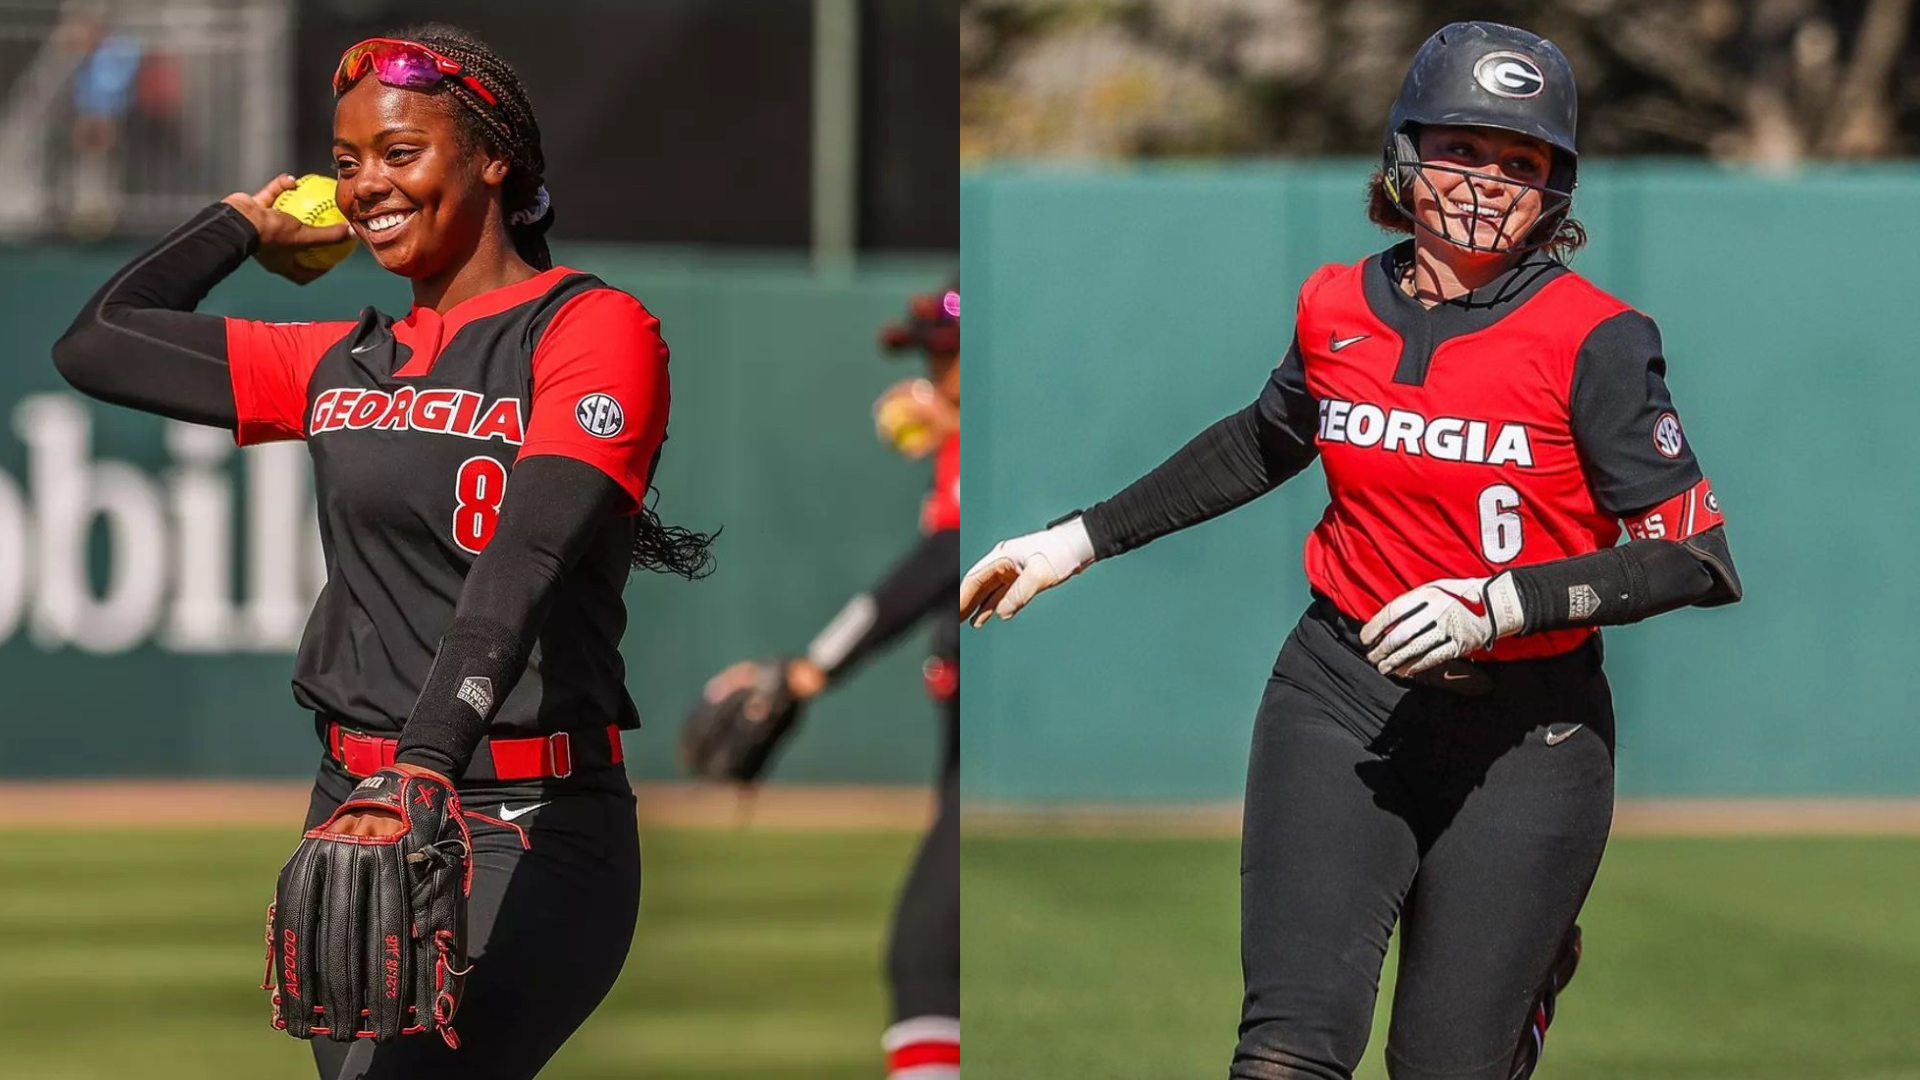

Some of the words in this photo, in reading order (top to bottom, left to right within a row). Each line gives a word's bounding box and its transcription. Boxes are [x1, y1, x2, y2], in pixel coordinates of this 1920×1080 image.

[309, 386, 525, 446] GEORGIA
[579, 394, 621, 436] SEC
[452, 455, 507, 556] 8
[1477, 482, 1524, 565] 6
[461, 685, 490, 711] ZONE
[285, 928, 300, 998] A2000
